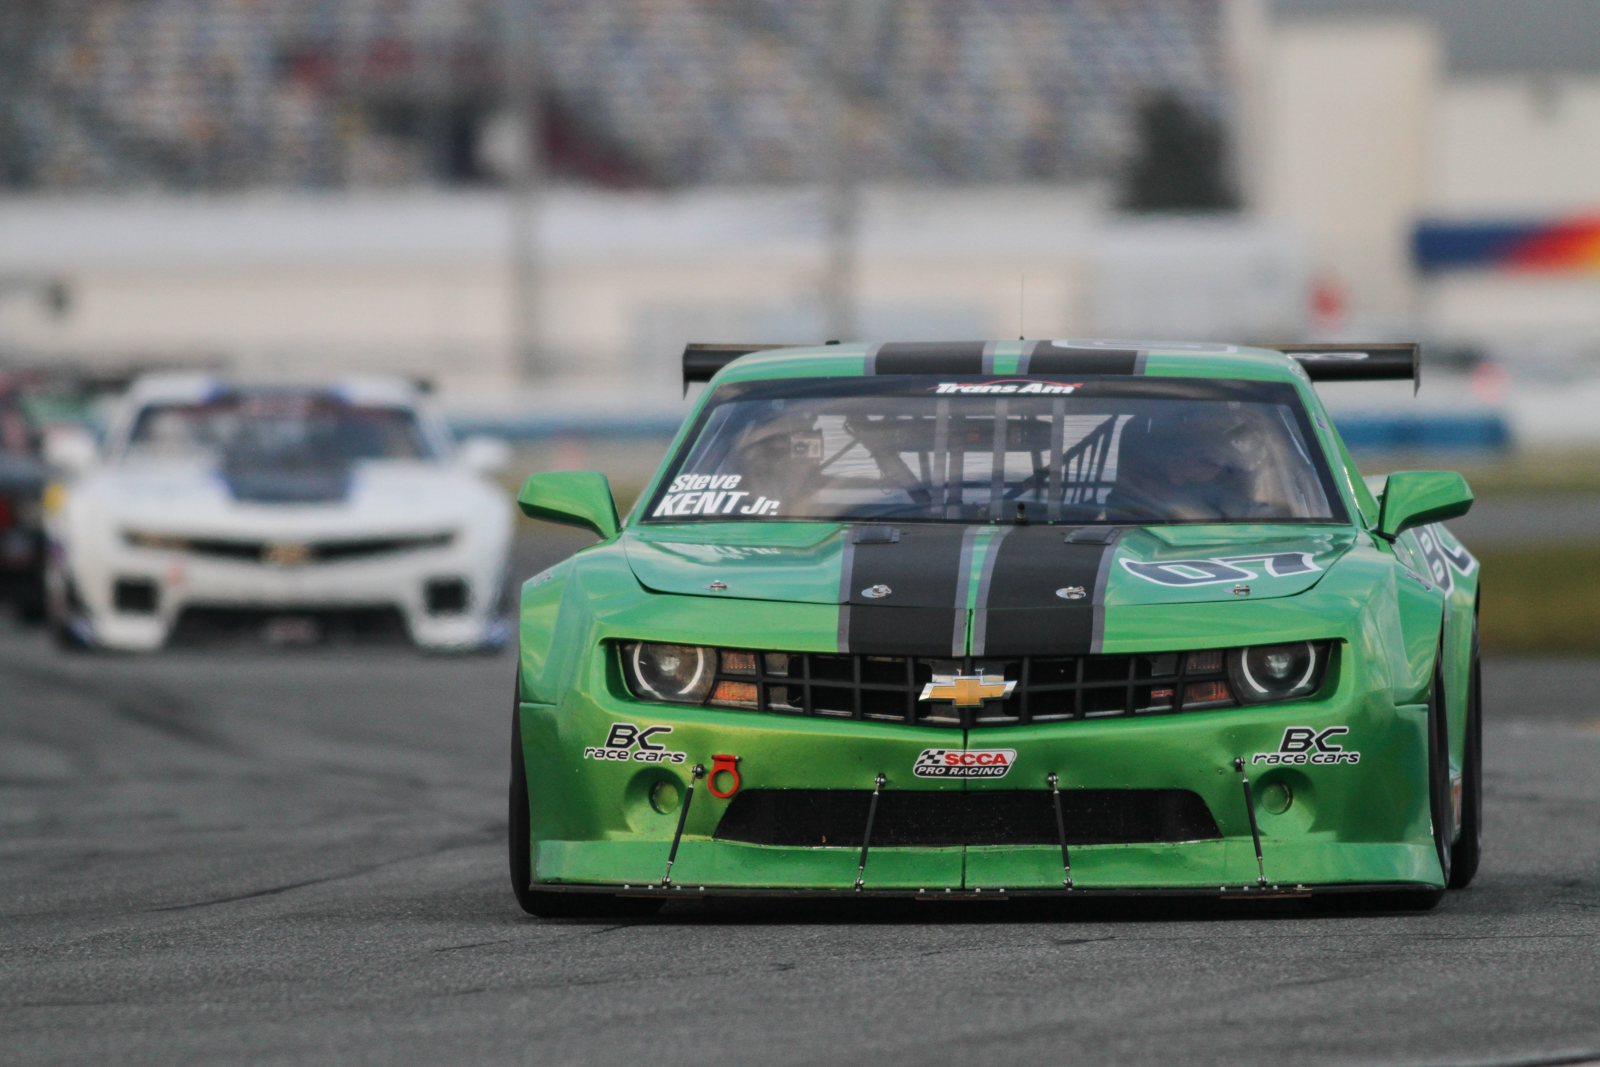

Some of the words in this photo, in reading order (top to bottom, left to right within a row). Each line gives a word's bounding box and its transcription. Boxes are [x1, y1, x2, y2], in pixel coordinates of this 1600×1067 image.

[935, 382, 1018, 394] Trans
[1017, 382, 1075, 394] Am
[668, 473, 742, 493] Steve
[652, 491, 749, 517] KENT
[740, 496, 780, 516] Jr.
[605, 722, 674, 751] BC
[1278, 726, 1349, 754] BC
[584, 746, 630, 761] race
[632, 750, 687, 764] cars
[944, 753, 1008, 766] SCCA
[1251, 752, 1308, 765] race
[1310, 751, 1361, 765] cars
[917, 766, 946, 775] PRO
[949, 767, 1005, 776] RACING
